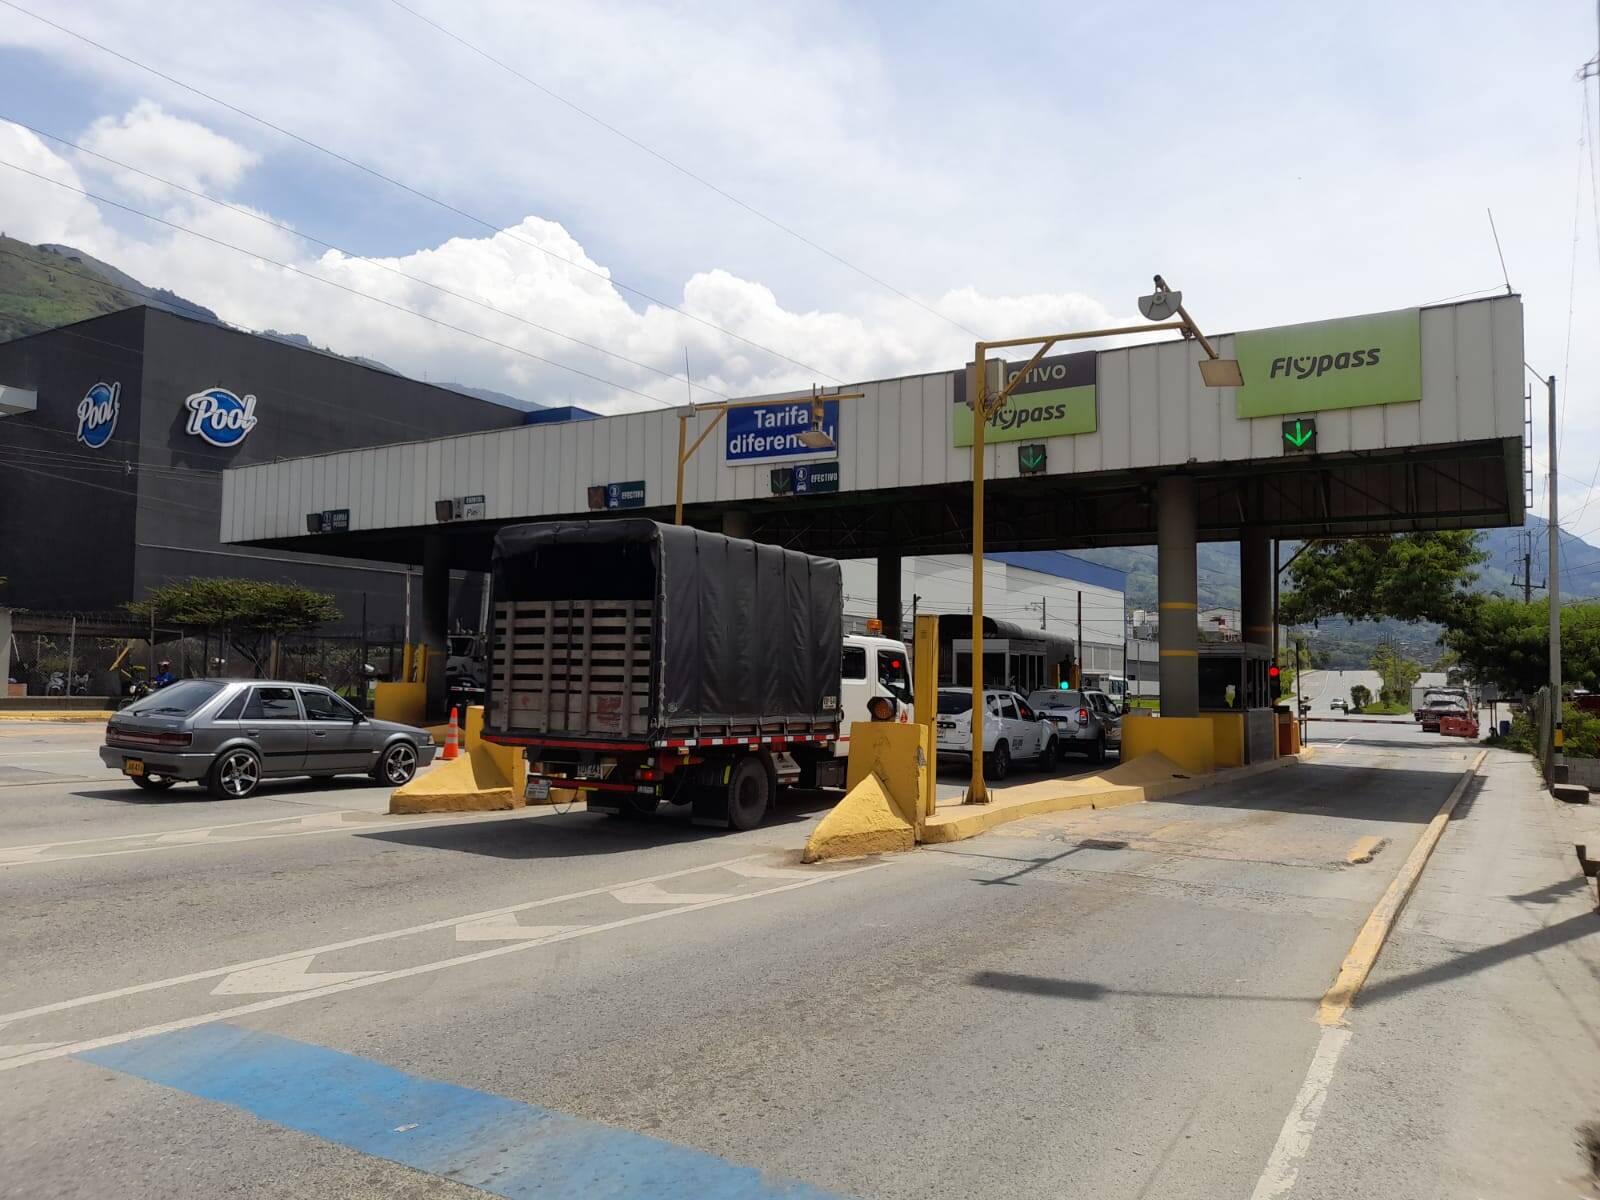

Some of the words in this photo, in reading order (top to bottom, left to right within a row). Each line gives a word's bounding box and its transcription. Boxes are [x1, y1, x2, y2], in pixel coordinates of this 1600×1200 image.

[1270, 348, 1381, 380] Flypass
[78, 382, 120, 440] Pool
[186, 394, 257, 434] Pool
[753, 406, 809, 429] Tarifa
[729, 425, 834, 453] diferenl
[810, 473, 838, 483] EFECTIVO
